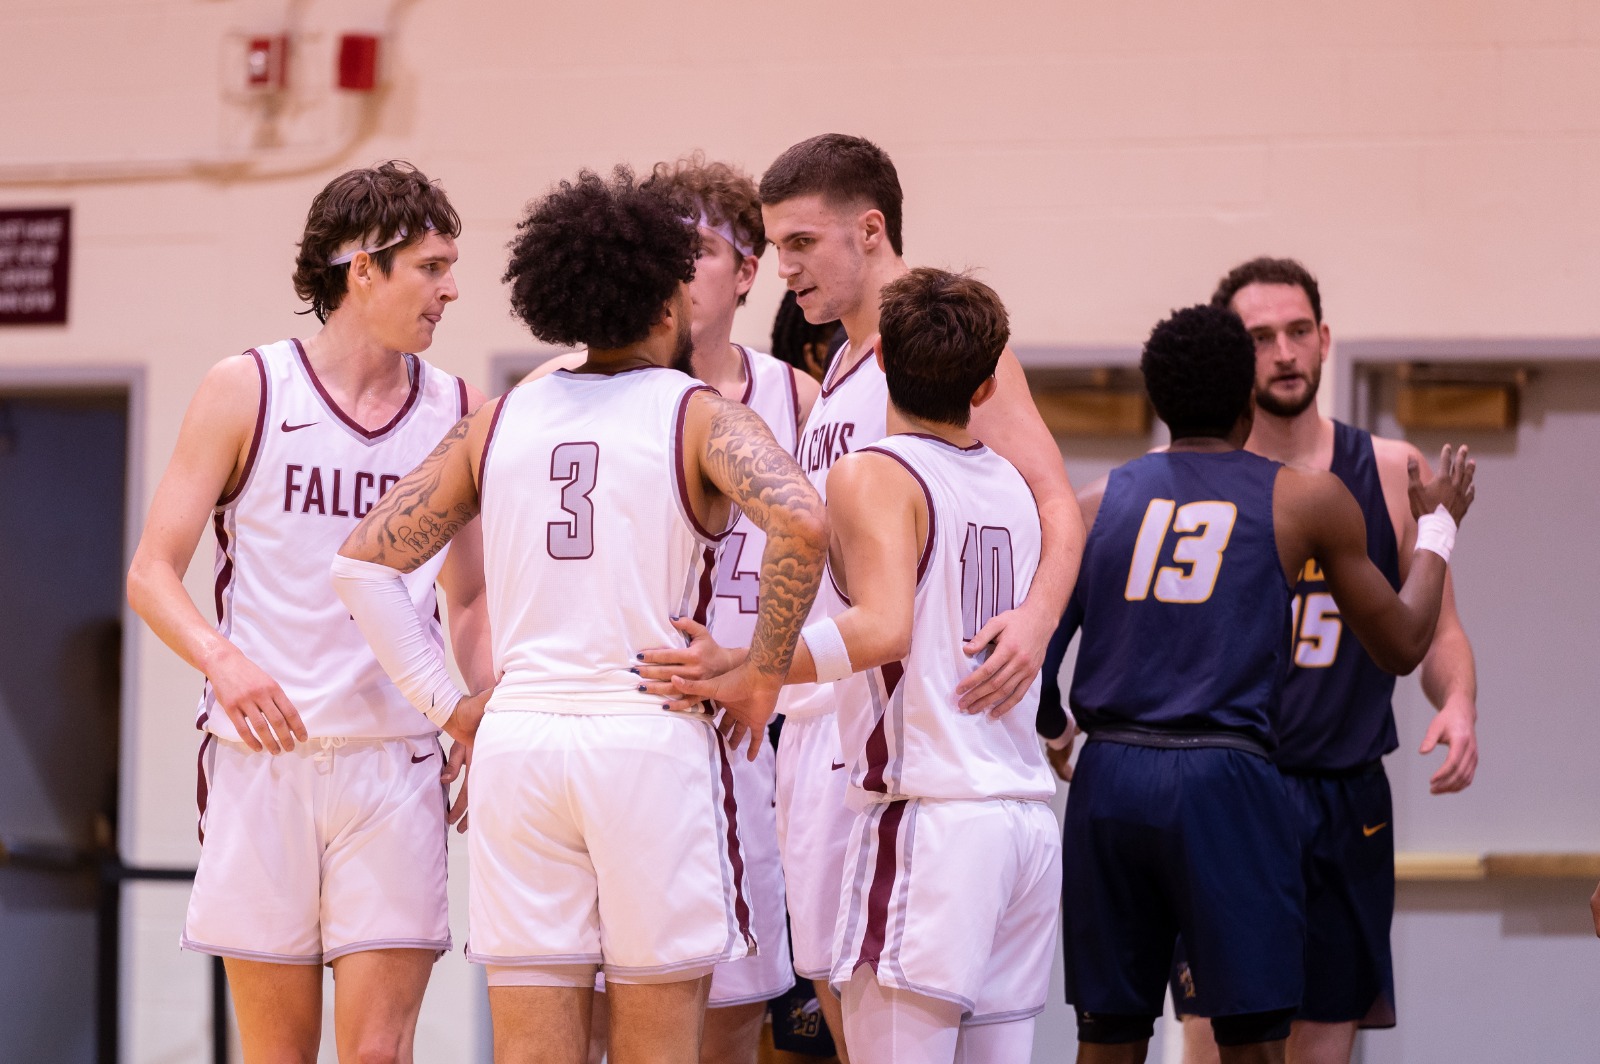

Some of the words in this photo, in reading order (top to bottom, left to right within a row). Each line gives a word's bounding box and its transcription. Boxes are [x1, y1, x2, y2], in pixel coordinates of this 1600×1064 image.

[547, 441, 600, 561] 3
[1124, 497, 1238, 604] 13
[716, 531, 761, 614] 4
[959, 521, 1015, 643] 10
